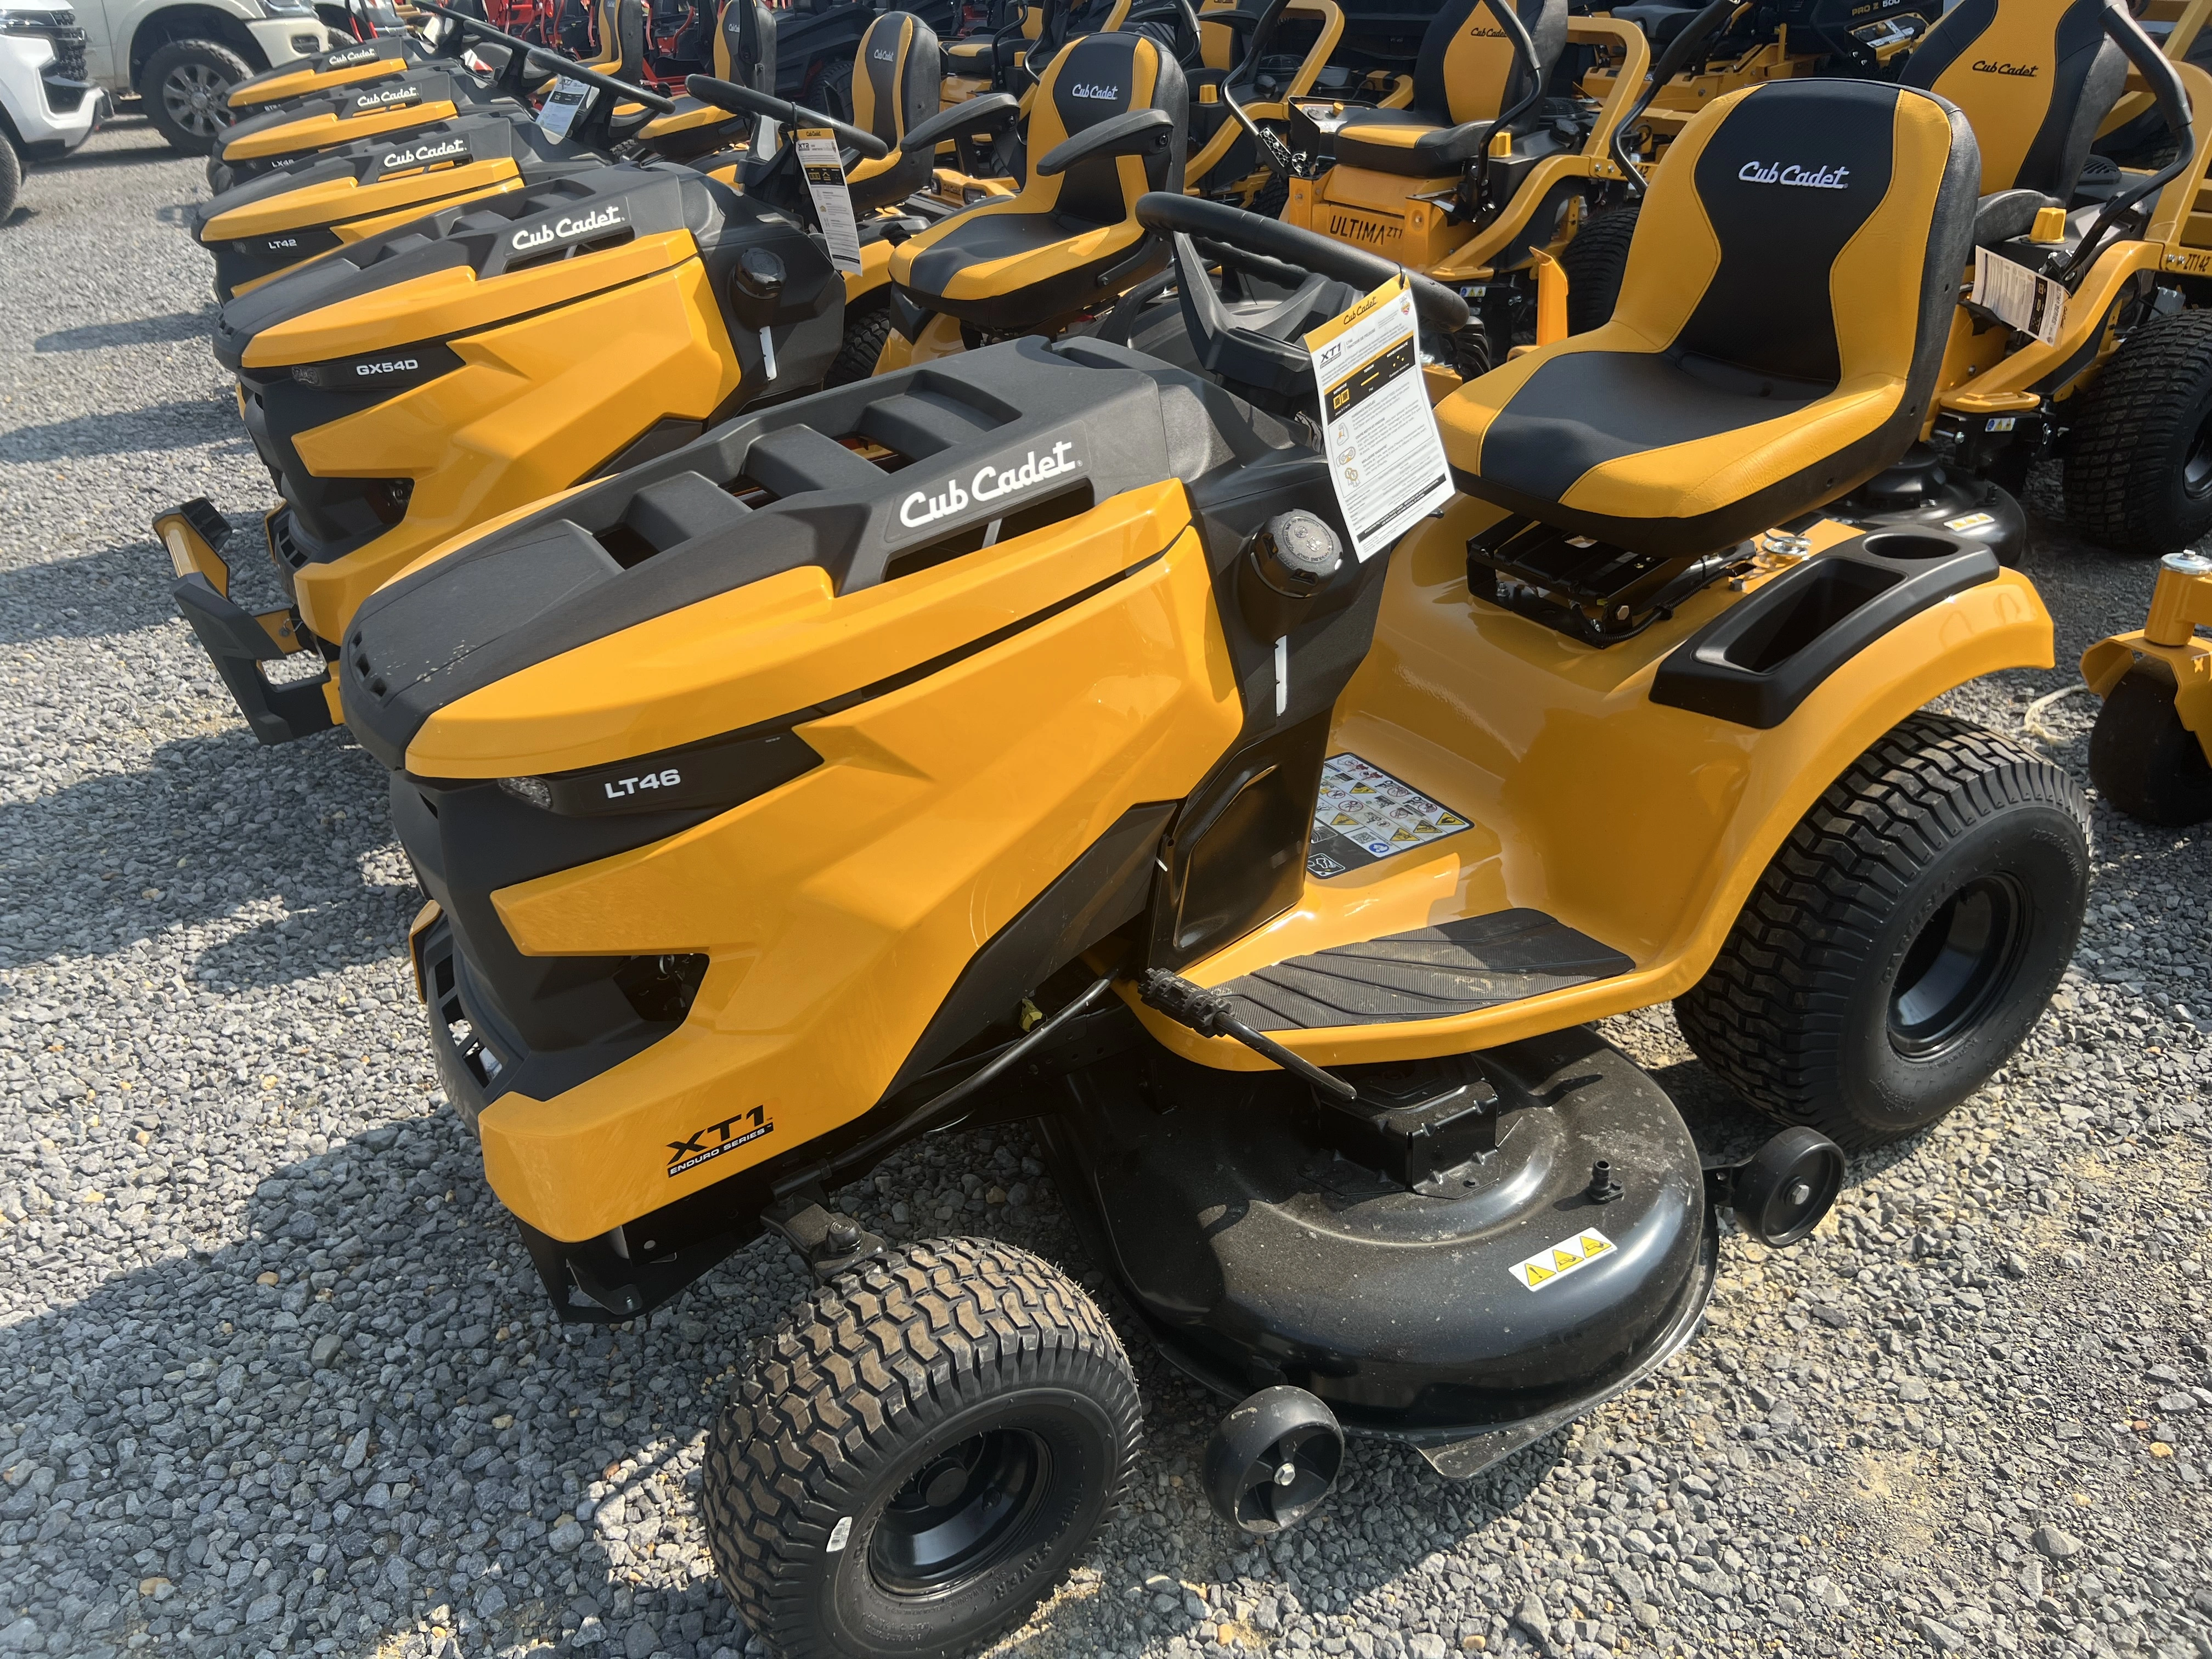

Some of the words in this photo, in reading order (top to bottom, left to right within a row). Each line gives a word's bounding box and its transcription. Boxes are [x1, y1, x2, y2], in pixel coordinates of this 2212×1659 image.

[1852, 5, 1870, 16] PRO
[1471, 27, 1486, 37] Cub
[1486, 28, 1508, 37] Cade
[329, 54, 347, 65] Cub
[347, 48, 376, 62] Cadet
[874, 49, 882, 60] Cub
[882, 50, 894, 62] Cadet
[1972, 61, 1997, 72] Cub
[1997, 64, 2038, 77] Cadet
[358, 93, 381, 107] Cub
[380, 87, 417, 103] Cadet
[1072, 84, 1089, 98] Cub
[1090, 85, 1118, 100] Cadet
[384, 150, 414, 167] Cub
[415, 140, 465, 160] Cadet
[1739, 161, 1779, 183] Cub
[1780, 165, 1849, 189] Cadet
[512, 224, 555, 250] Cub
[556, 206, 621, 238] Cadet
[1330, 215, 1385, 245] ULTIMA
[1387, 227, 1403, 239] ZT1
[269, 239, 297, 249] LT42
[1344, 311, 1356, 325] Cub
[1357, 296, 1378, 316] Cadet
[1321, 342, 1342, 363] XT1
[356, 359, 419, 376] GX54D
[900, 479, 969, 528] Cub
[972, 441, 1076, 501] Cadet
[605, 769, 681, 799] LT46
[667, 1104, 764, 1166] XT1
[669, 1148, 720, 1175] ENDURO
[723, 1128, 765, 1151] SERIES
